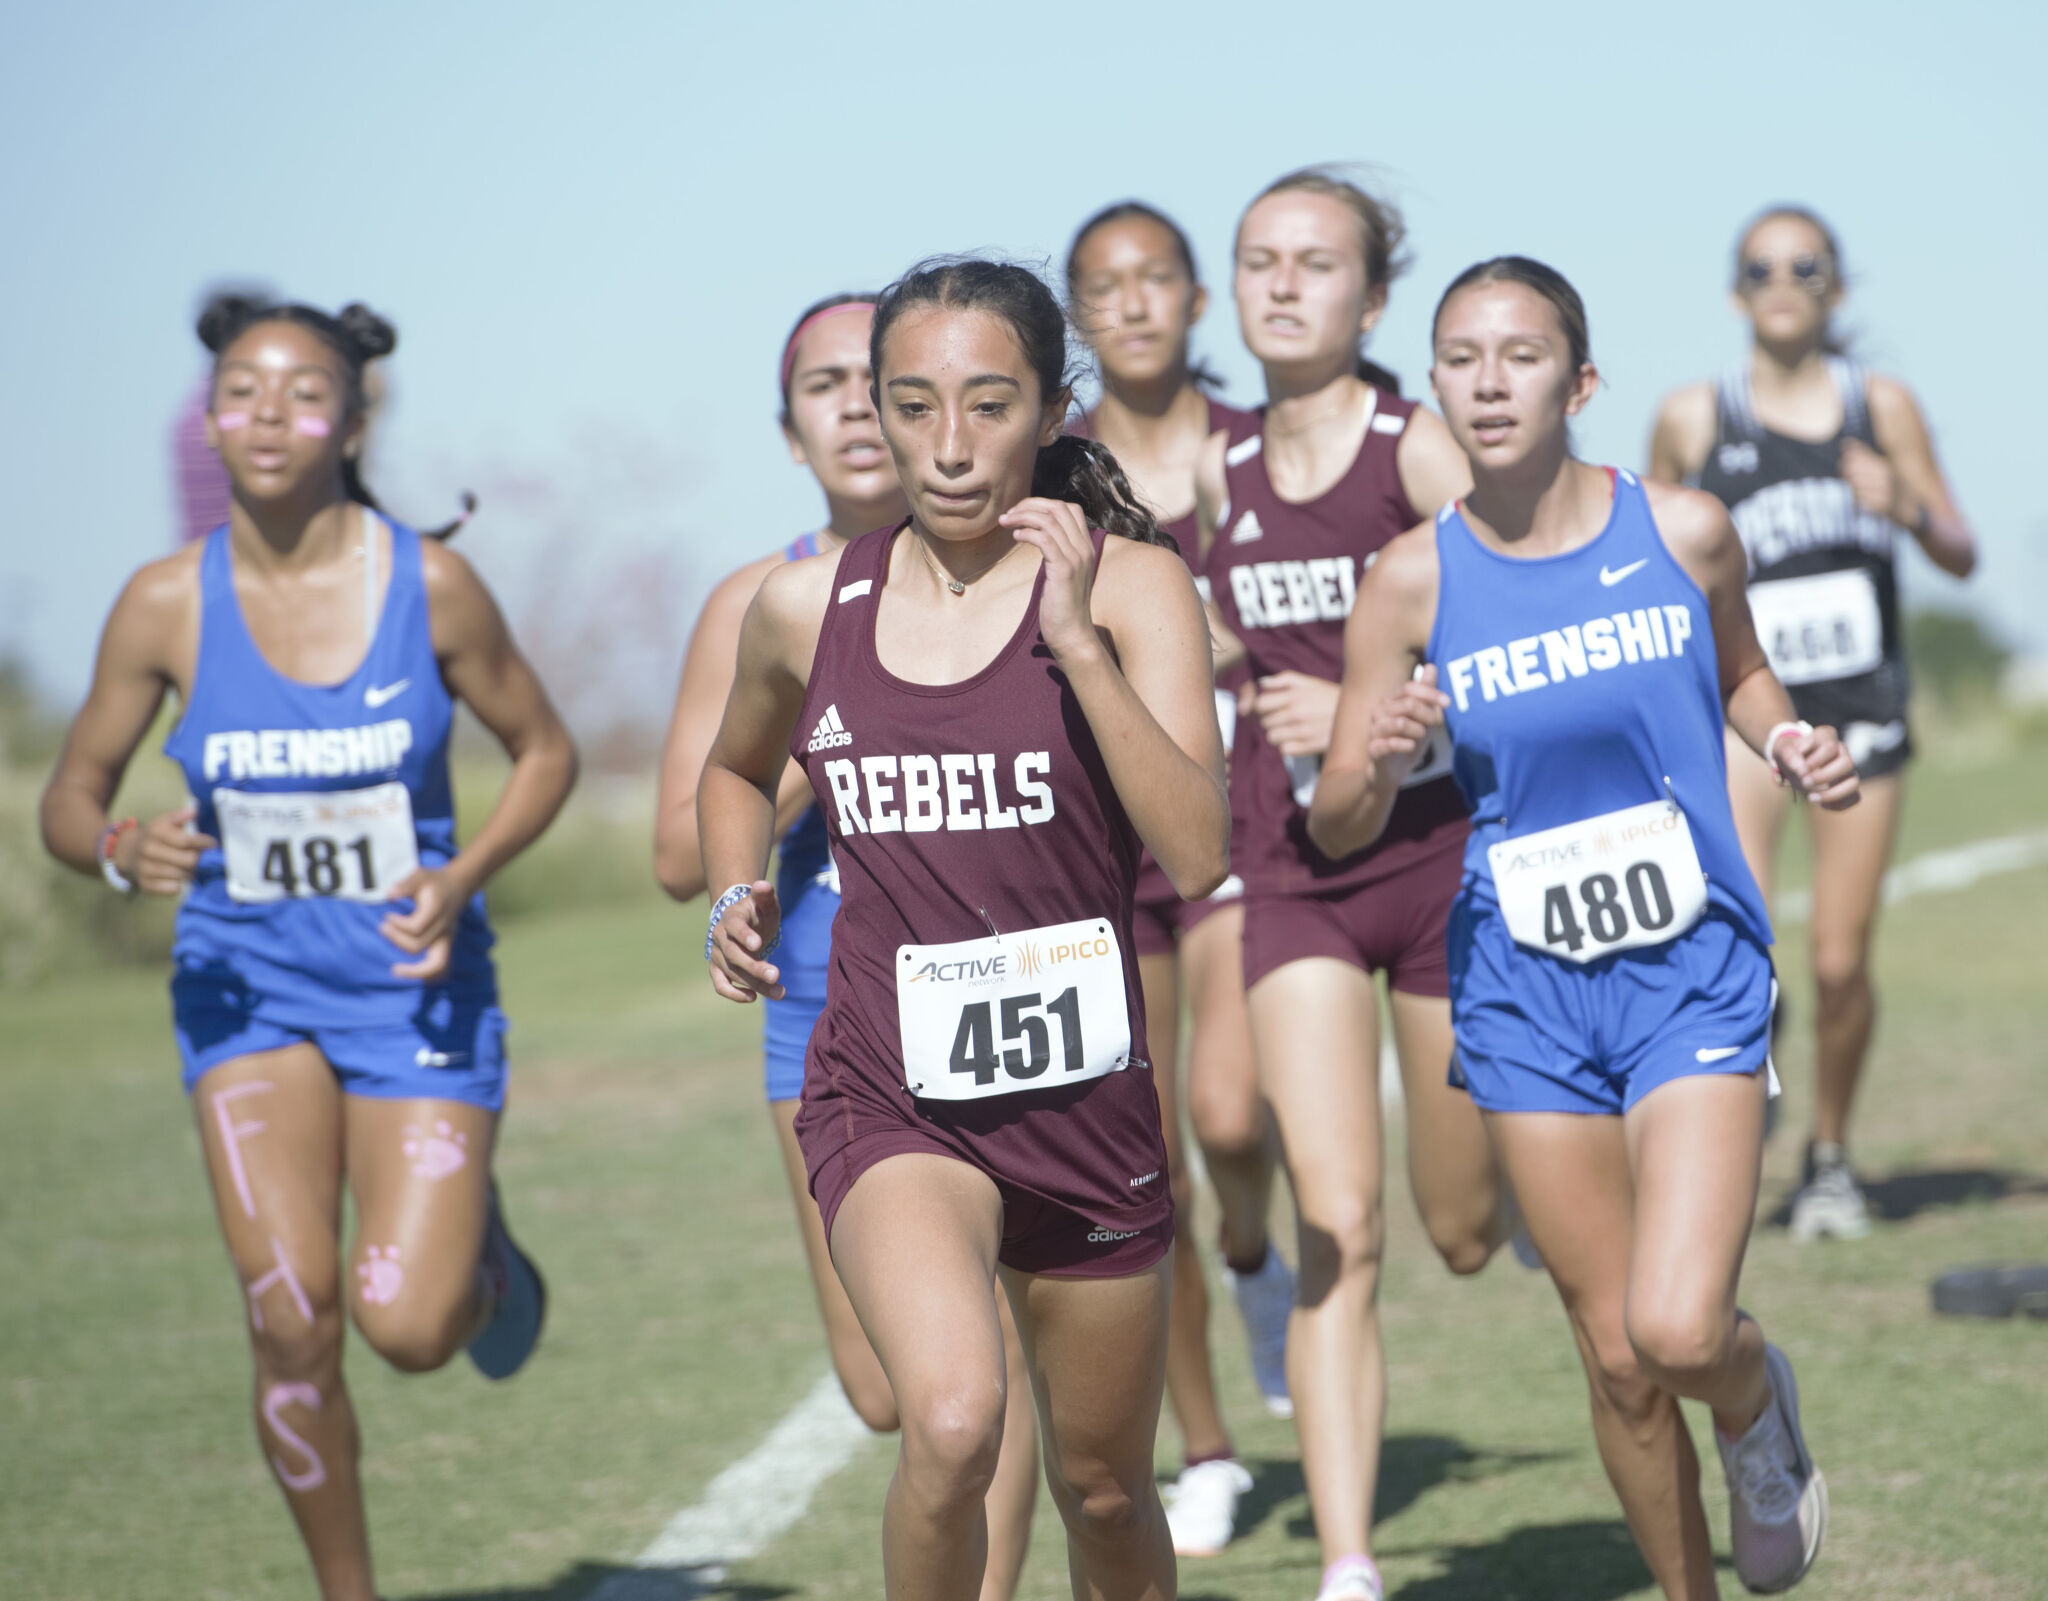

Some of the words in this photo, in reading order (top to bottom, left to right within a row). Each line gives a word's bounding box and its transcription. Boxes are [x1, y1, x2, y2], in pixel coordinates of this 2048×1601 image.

[1230, 550, 1379, 629] REBEL
[1447, 604, 1692, 713] FRENSHIP
[203, 718, 412, 781] FRENSHIP
[808, 731, 853, 752] adidas
[824, 751, 1055, 836] REBELS
[1620, 815, 1678, 843] IPICO
[263, 833, 377, 894] 481
[1543, 861, 1675, 953] 480
[909, 955, 1007, 984] ACTIVE
[1049, 938, 1109, 965] IPICO
[967, 975, 1007, 988] network
[949, 986, 1084, 1086] 451
